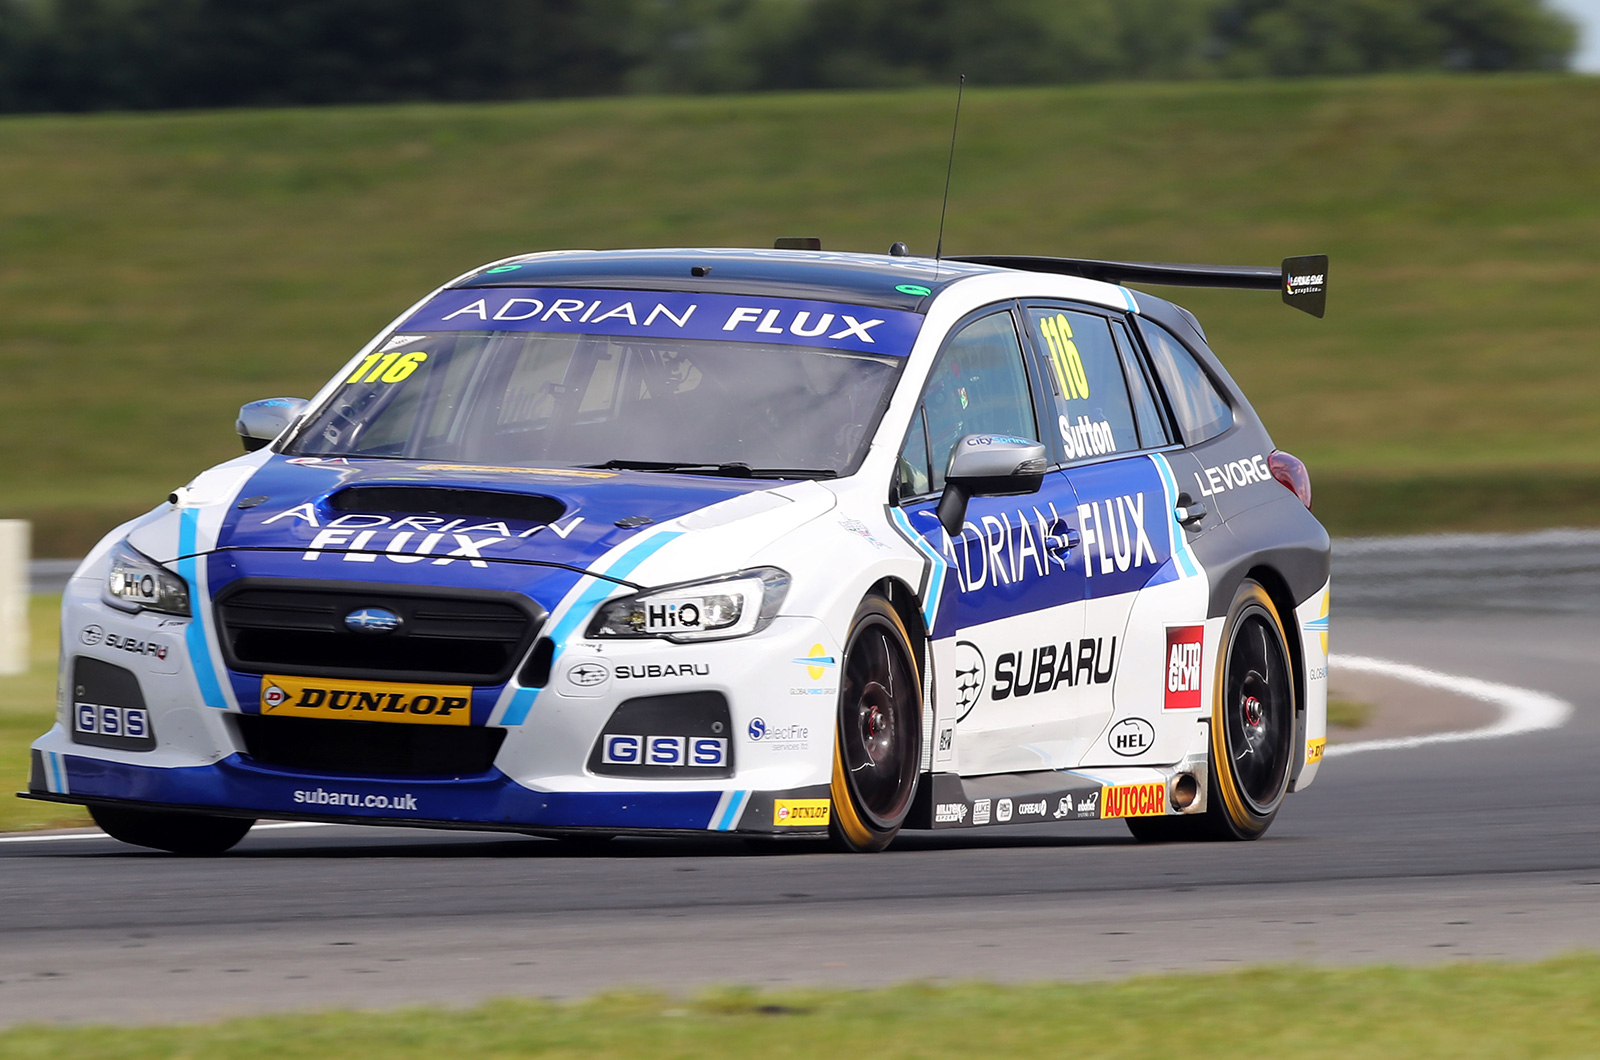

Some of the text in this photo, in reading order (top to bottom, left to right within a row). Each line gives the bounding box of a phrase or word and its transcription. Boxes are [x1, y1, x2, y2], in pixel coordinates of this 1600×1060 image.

[442, 298, 886, 344] ADRIAN FLUX
[346, 351, 428, 384] 116
[1040, 313, 1090, 400] 116
[1058, 414, 1117, 460] Sutton
[1193, 454, 1272, 497] LEVORG
[261, 502, 585, 540] ADRIAN
[302, 528, 507, 569] FLUX
[941, 492, 1158, 593] ADRIAN FLUX
[123, 573, 155, 598] HiQ
[649, 603, 701, 628] HiQ
[105, 633, 169, 660] SUBARU
[1169, 642, 1202, 668] AUTO
[615, 663, 710, 679] SUBARU
[991, 635, 1117, 701] SUBARU
[1168, 665, 1201, 692] GLYM
[295, 687, 468, 716] DUNLOP
[79, 705, 144, 736] GSS
[609, 737, 721, 764] GSS
[1117, 733, 1146, 748] HEL
[293, 788, 417, 810] subaru.co.uk
[791, 807, 828, 819] DUNLOP
[1105, 785, 1165, 817] AUTOCAR
